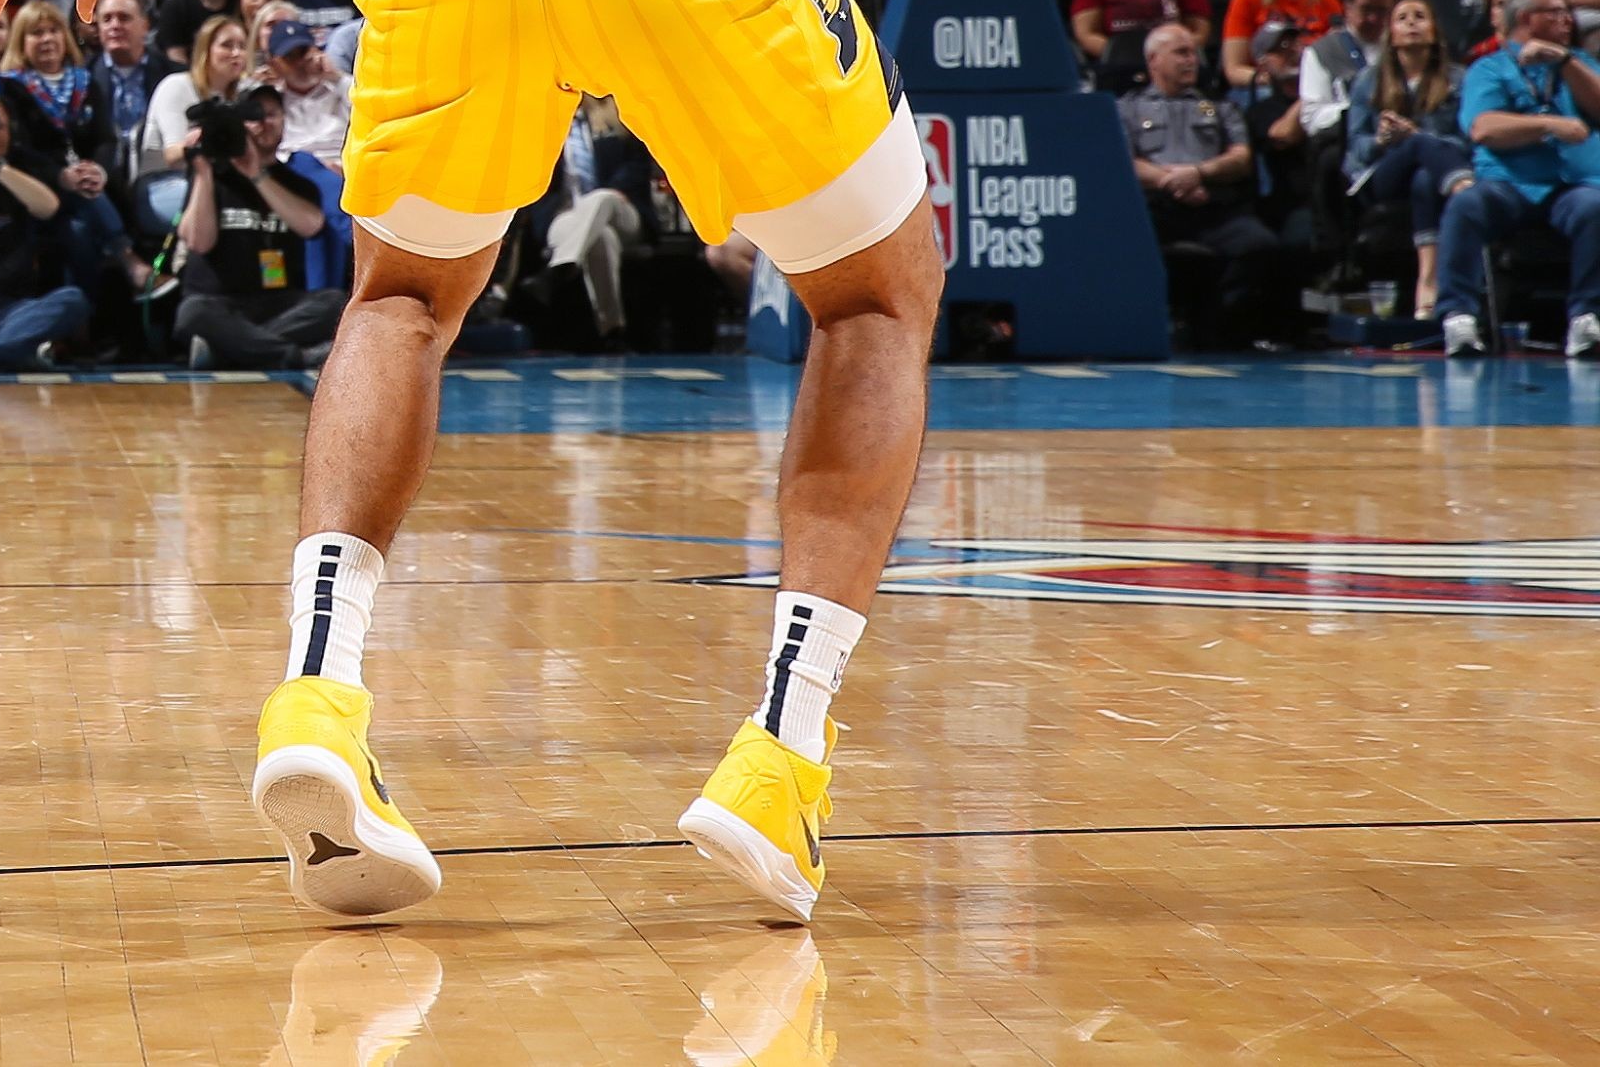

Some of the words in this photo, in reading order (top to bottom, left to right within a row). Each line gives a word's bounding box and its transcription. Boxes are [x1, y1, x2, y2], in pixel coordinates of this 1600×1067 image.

[933, 16, 1022, 69] @NBA
[966, 115, 1028, 167] NBA
[967, 168, 1078, 226] League
[968, 218, 1045, 268] Pass
